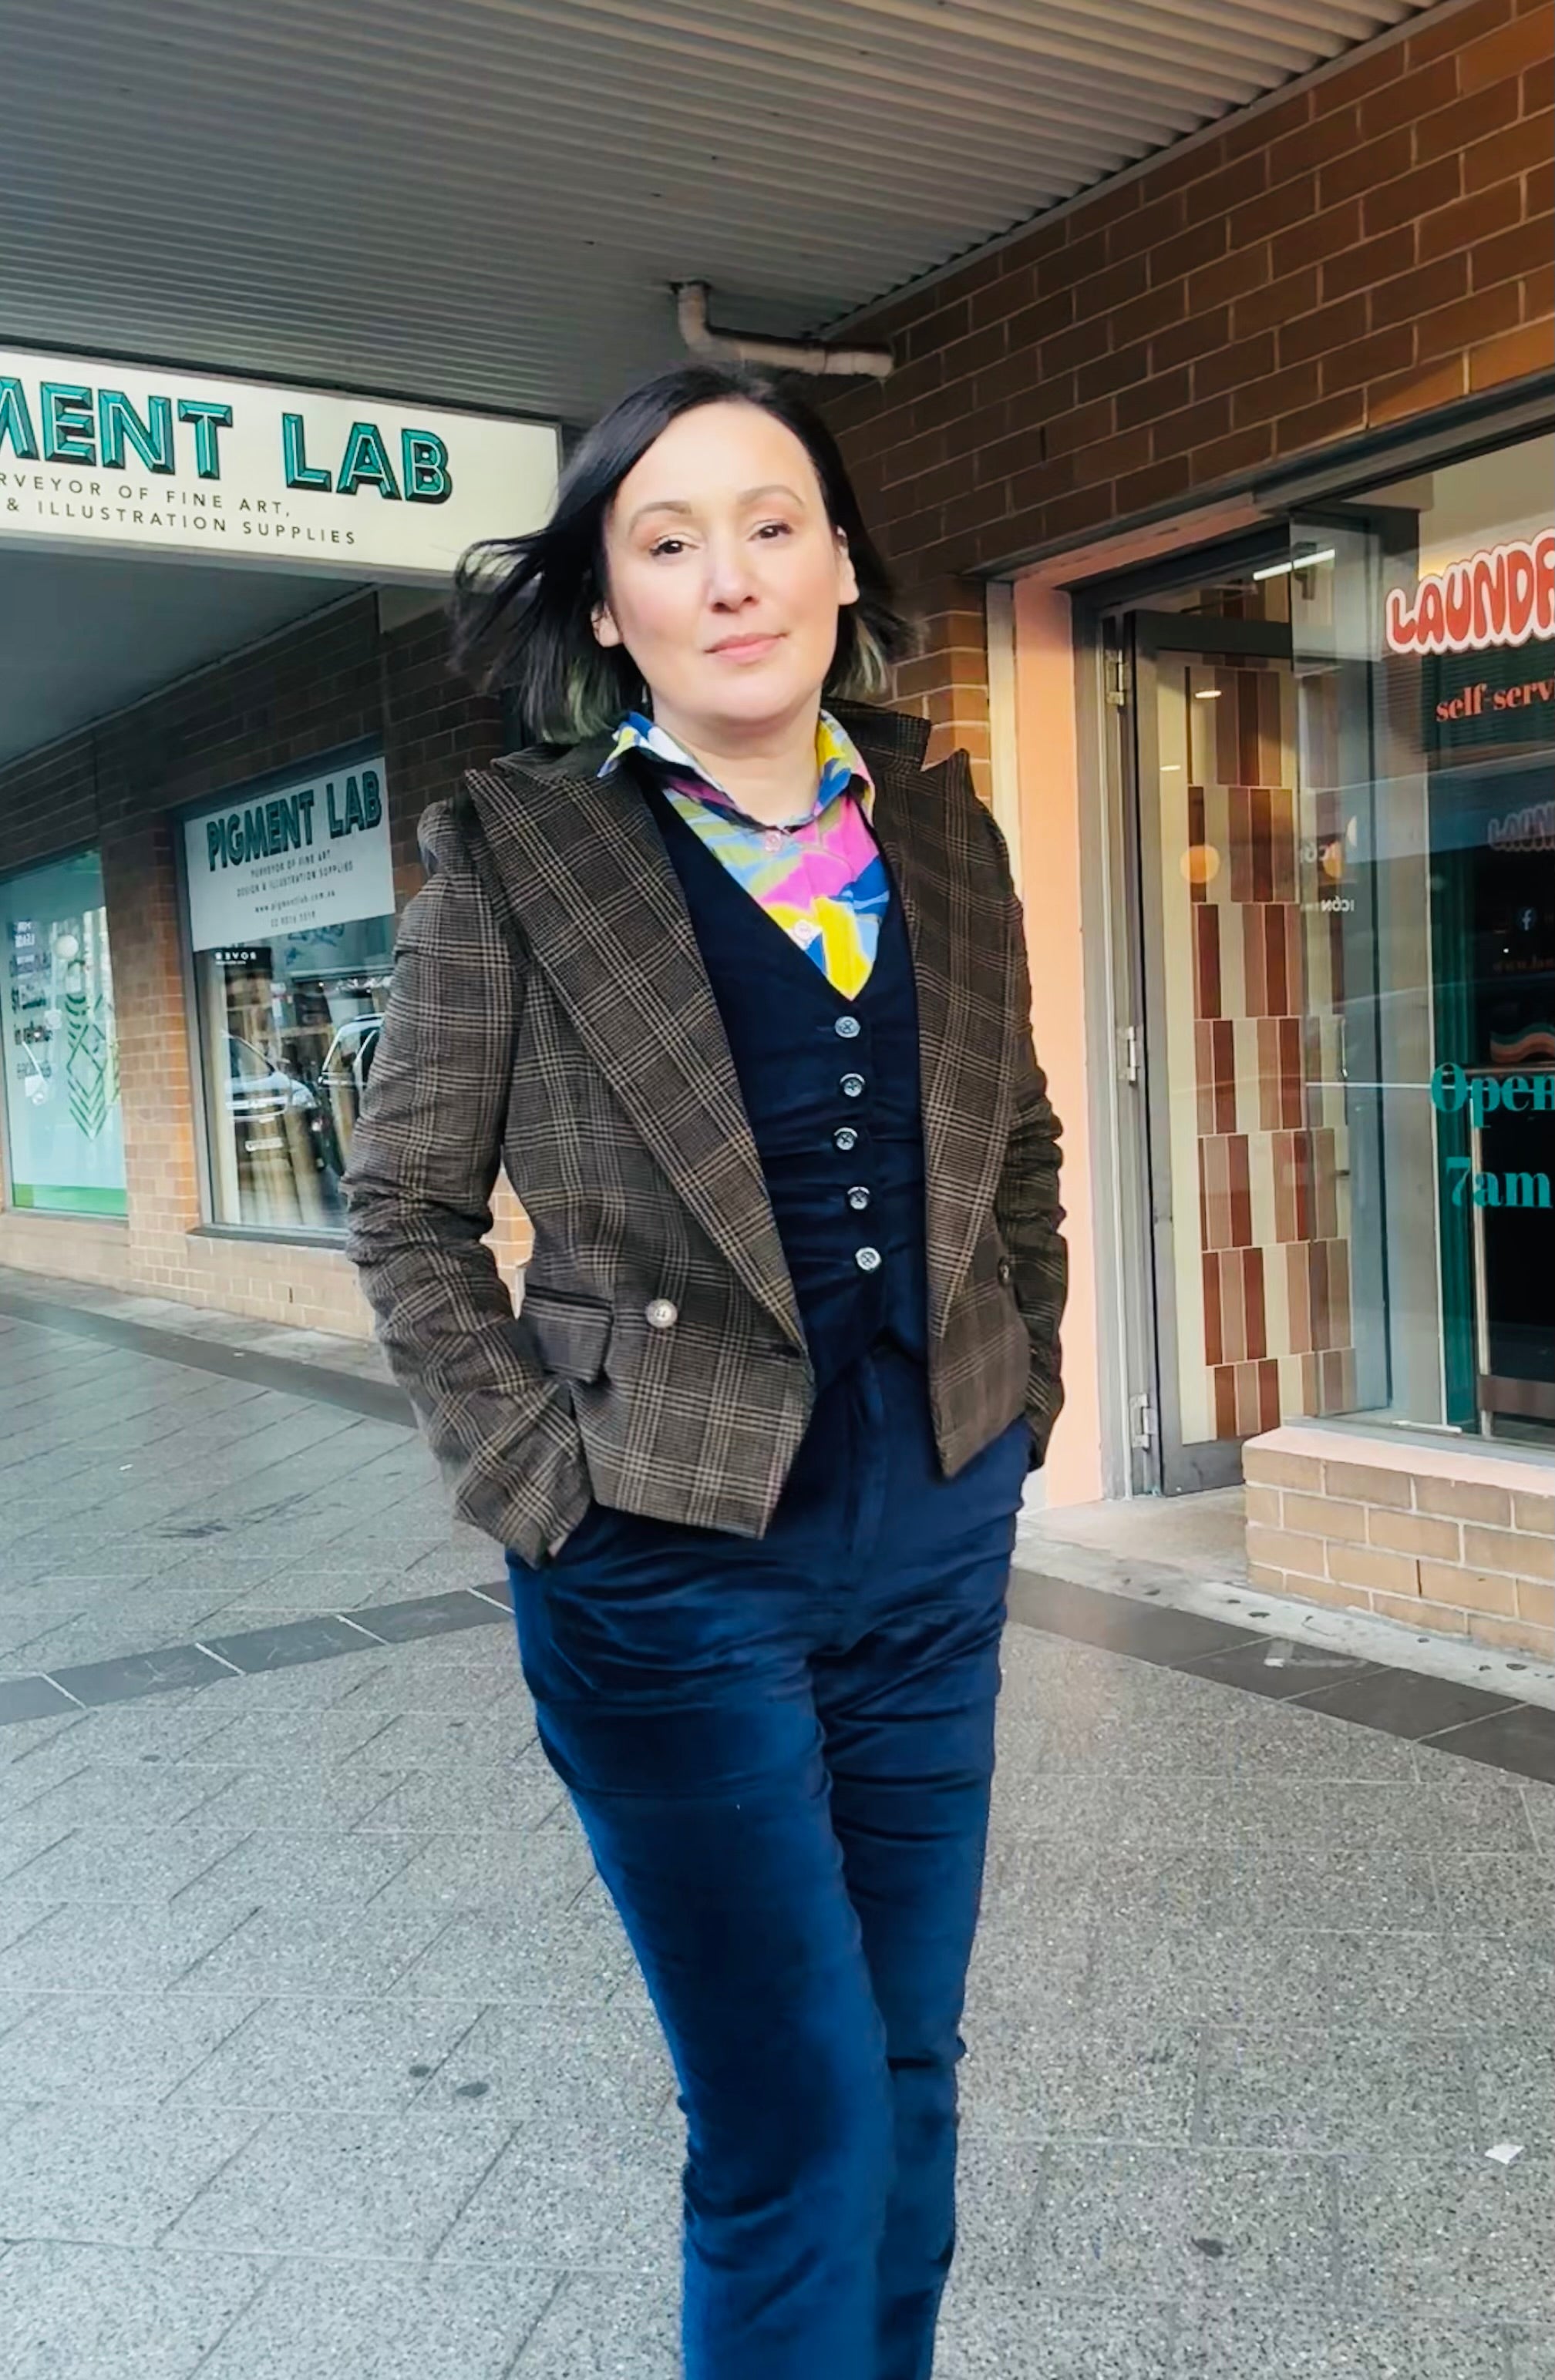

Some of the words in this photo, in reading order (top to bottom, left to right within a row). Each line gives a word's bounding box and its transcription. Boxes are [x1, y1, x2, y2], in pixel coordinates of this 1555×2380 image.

[282, 412, 453, 505] LAB
[7, 498, 19, 511] &
[39, 501, 226, 532] ILLUSTRATION
[243, 522, 355, 544] SUPPLIES
[119, 486, 149, 500] OF
[167, 490, 222, 509] FINE
[239, 499, 290, 517] ART,
[207, 789, 315, 872] PIGMENT
[326, 771, 382, 839] LAB
[1431, 1062, 1555, 1128] Open
[1446, 1156, 1553, 1208] 7am
